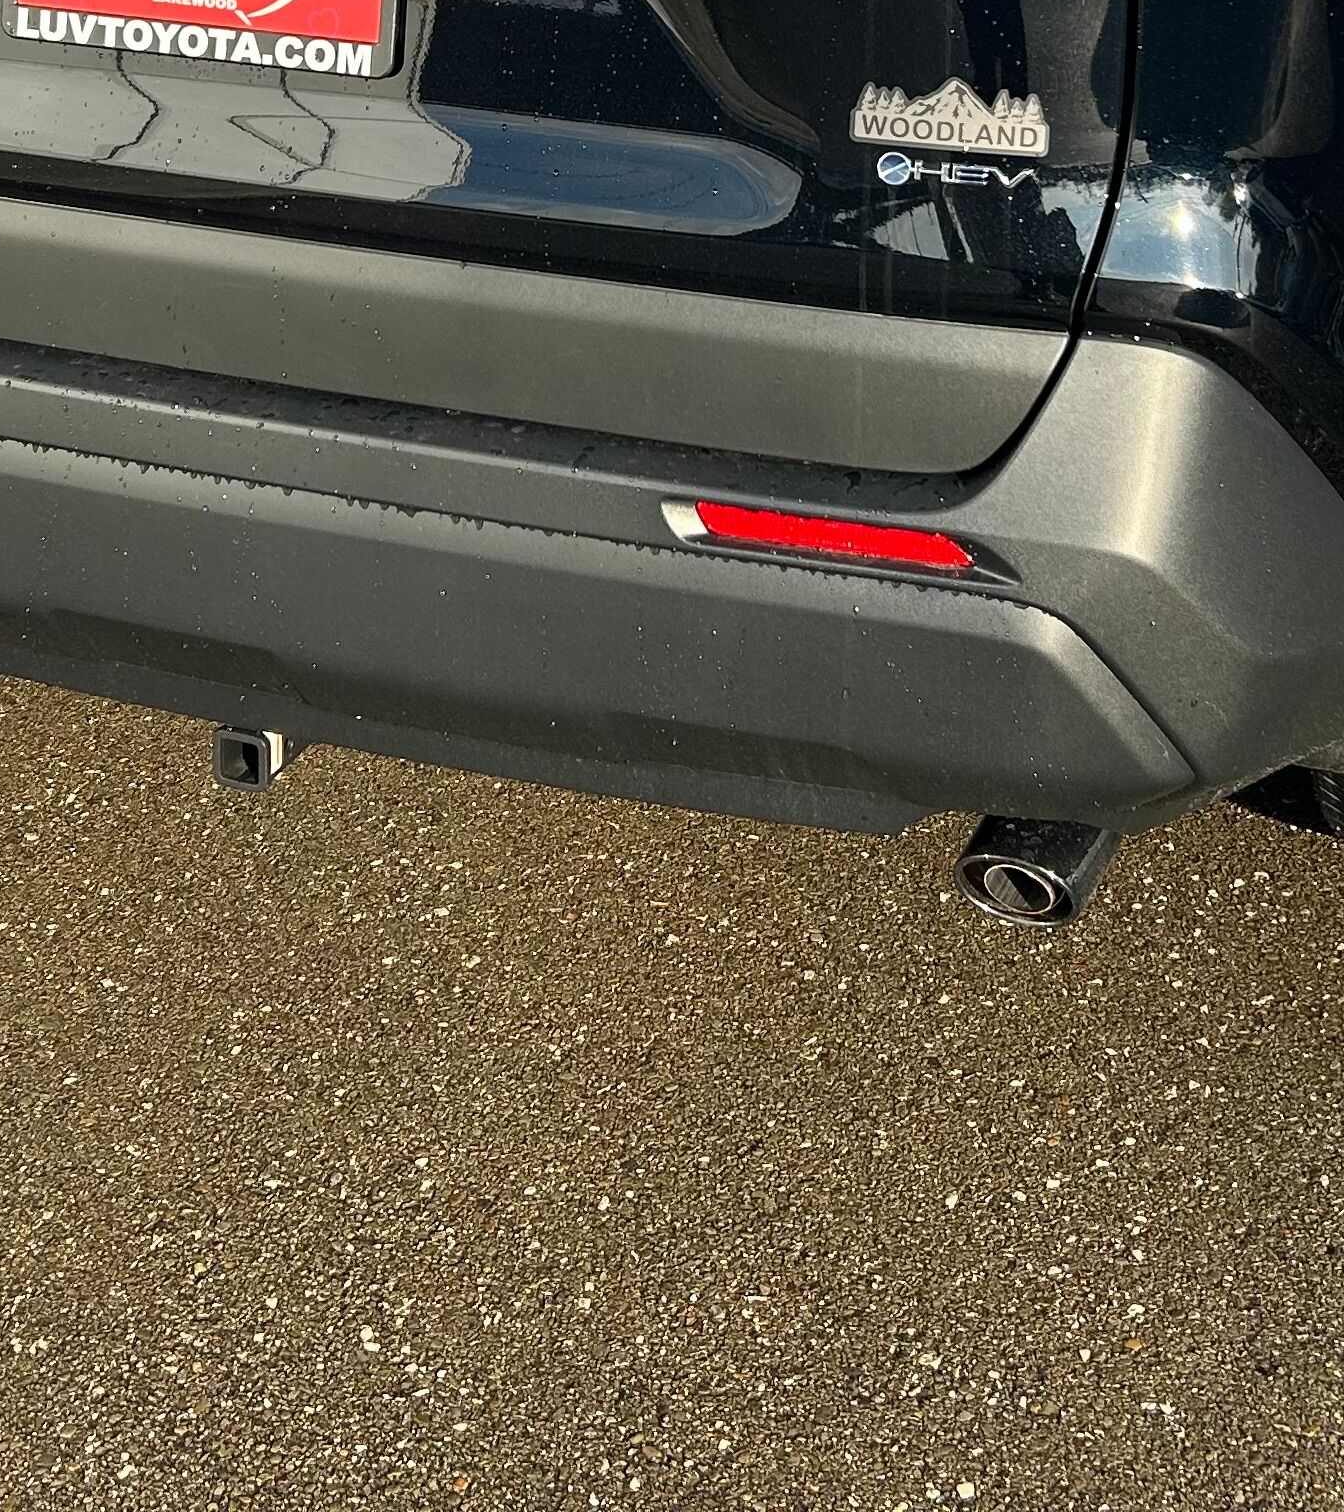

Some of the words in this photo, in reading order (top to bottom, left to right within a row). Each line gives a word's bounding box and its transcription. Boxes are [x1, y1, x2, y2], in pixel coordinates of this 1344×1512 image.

[16, 6, 373, 77] LUVTOYOTA.COM
[862, 113, 1038, 148] WOODLAND
[913, 159, 1035, 188] HEV
